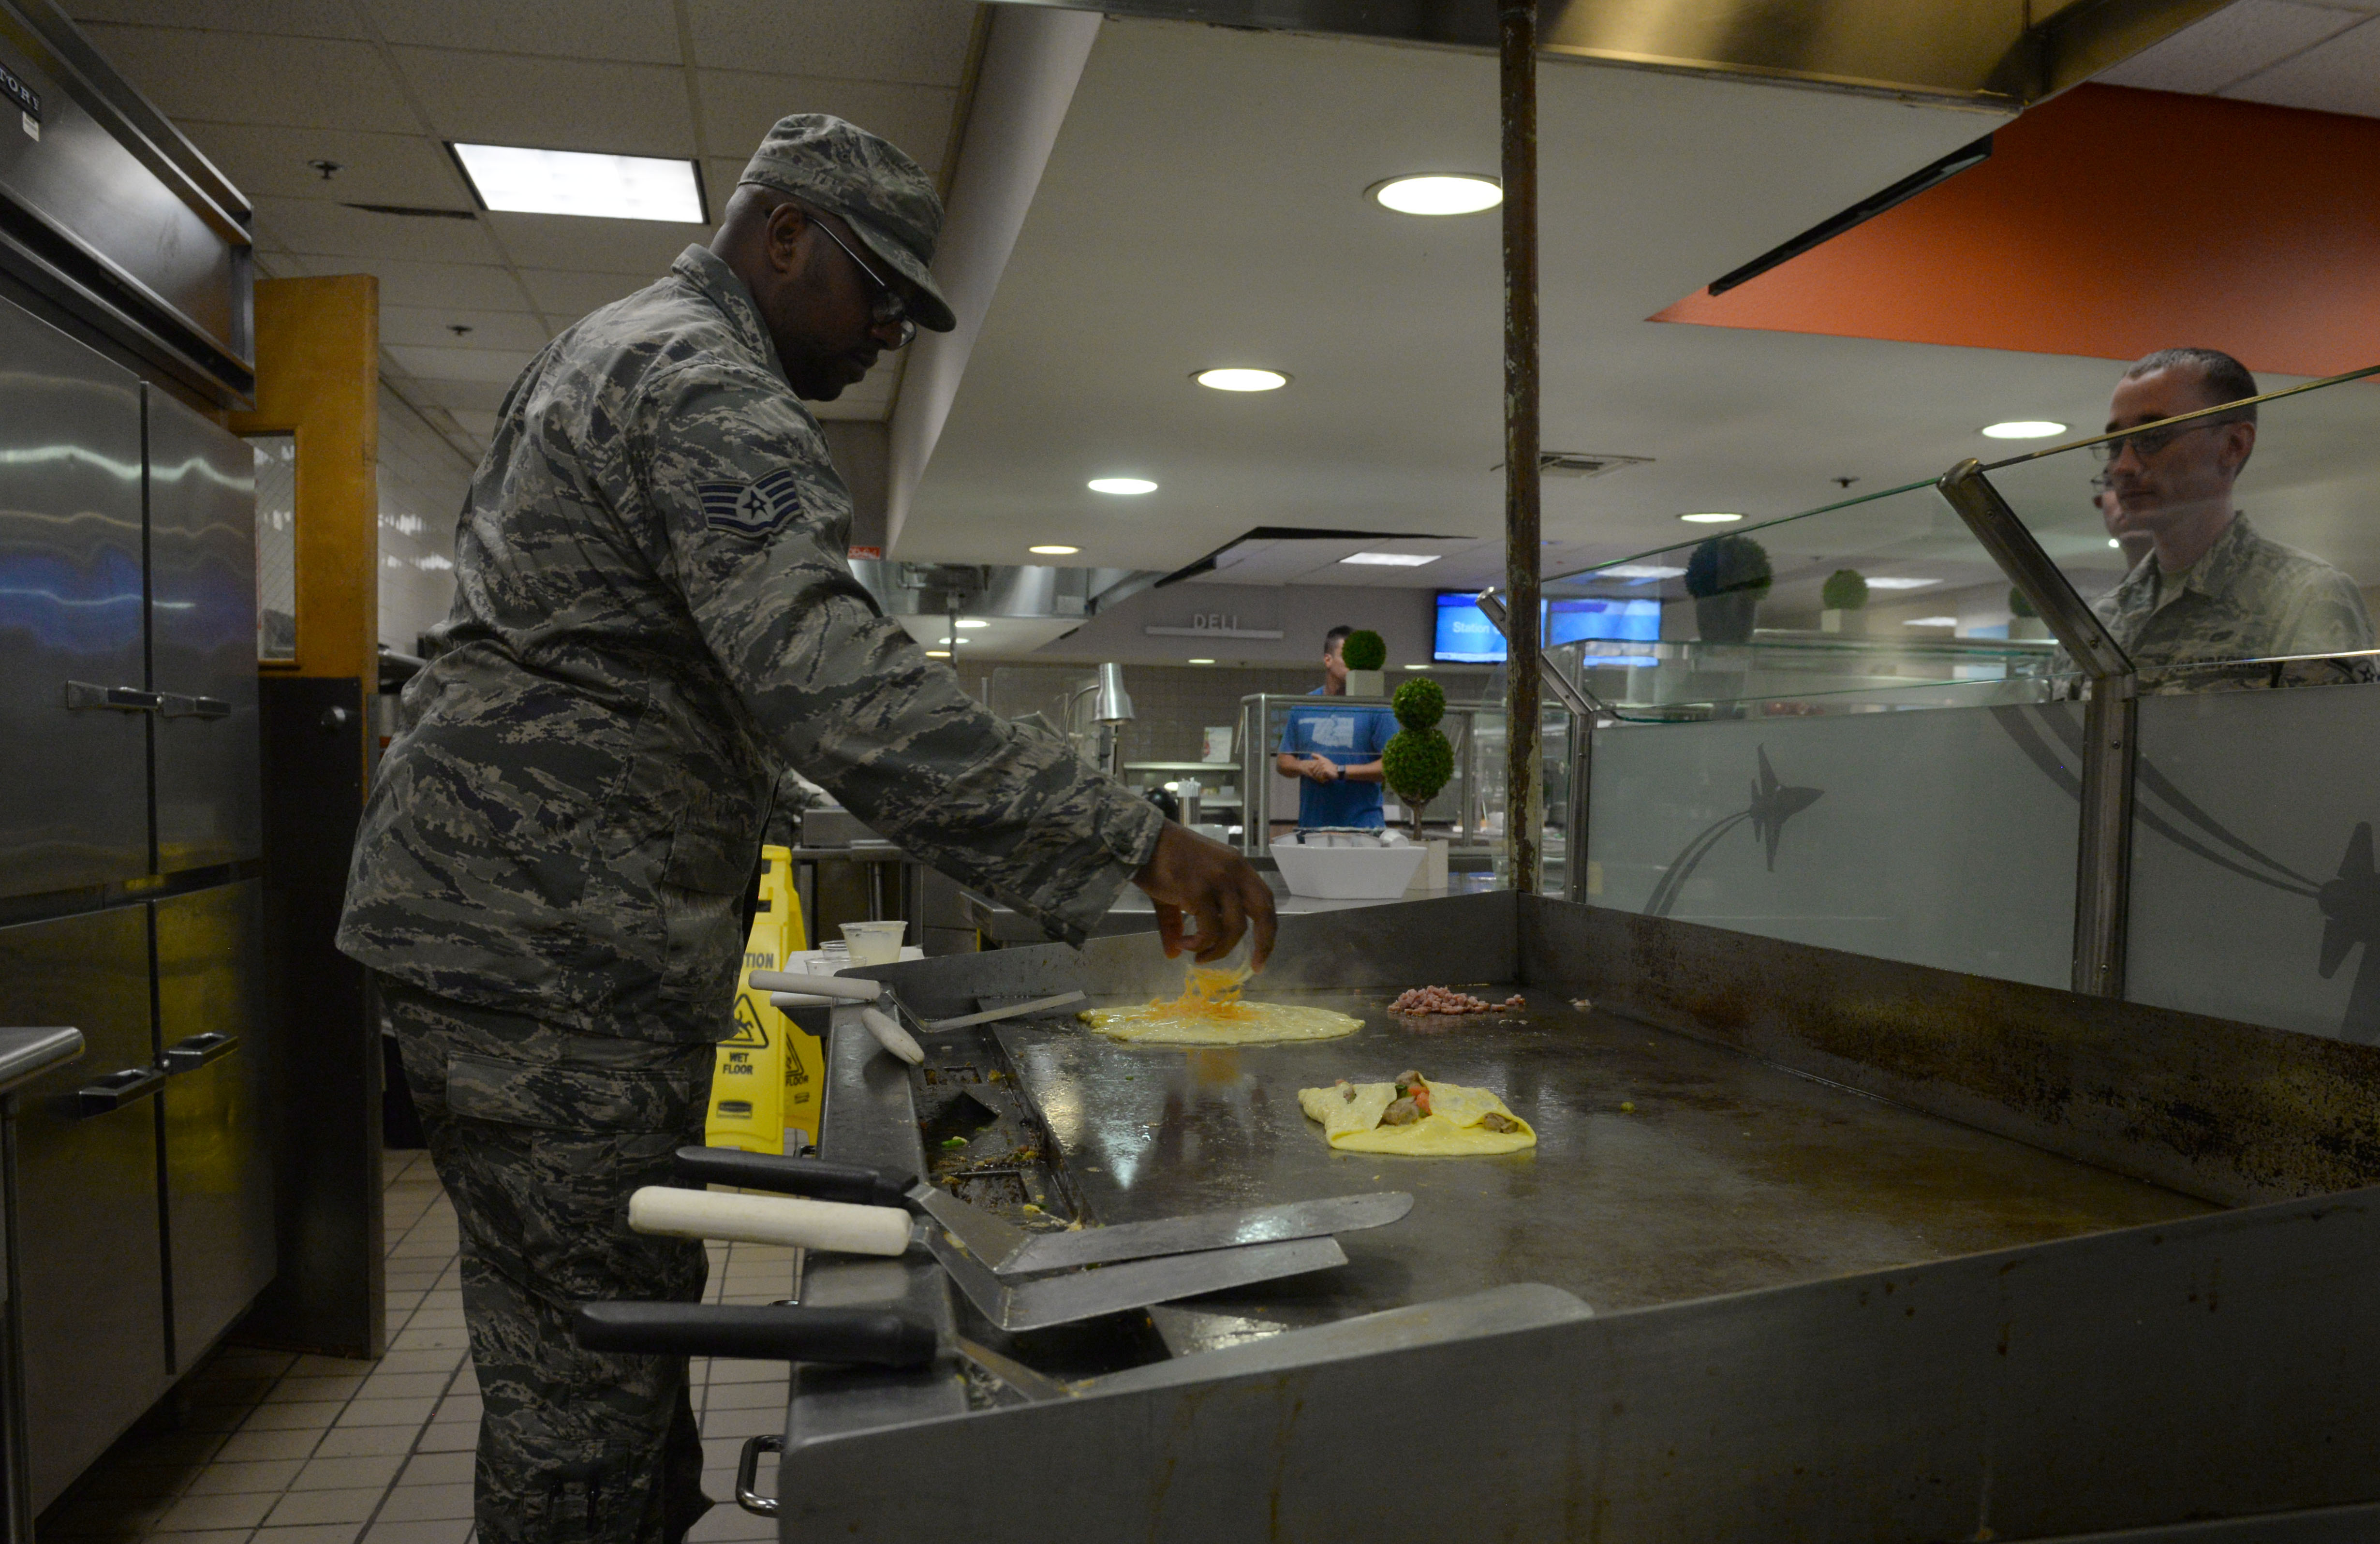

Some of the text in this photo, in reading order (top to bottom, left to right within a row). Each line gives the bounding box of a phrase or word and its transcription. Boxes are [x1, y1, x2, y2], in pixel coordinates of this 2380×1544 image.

[1194, 614, 1237, 629] DELI
[1452, 621, 1490, 633] Station
[729, 1052, 749, 1063] WET
[723, 1064, 753, 1075] FLOOR
